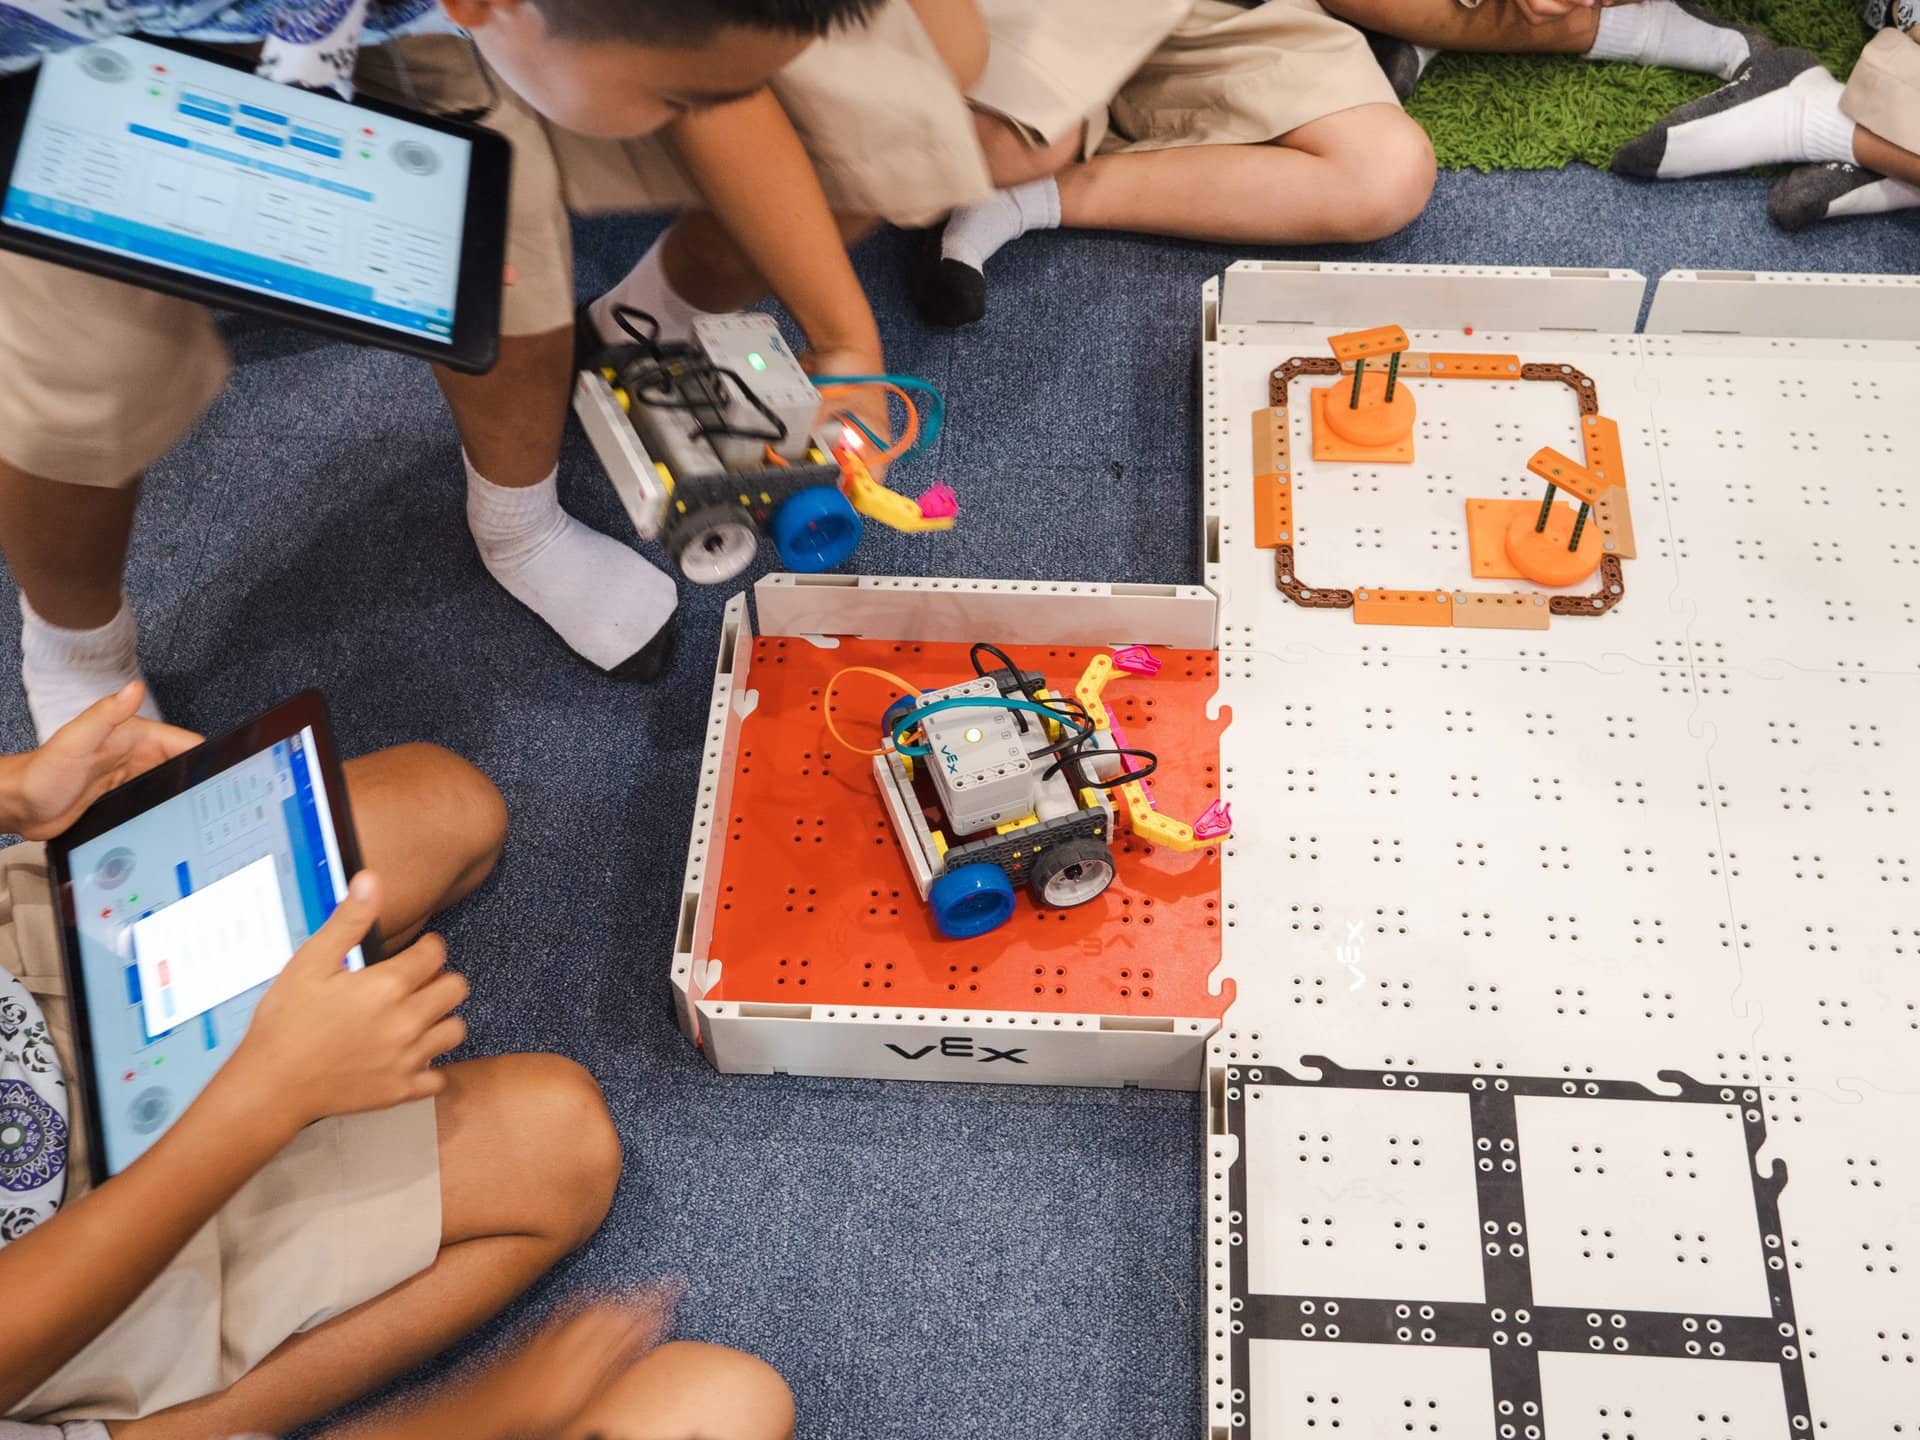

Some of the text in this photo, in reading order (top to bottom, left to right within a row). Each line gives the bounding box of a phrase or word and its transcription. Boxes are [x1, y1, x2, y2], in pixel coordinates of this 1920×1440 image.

[941, 745, 958, 774] VEX
[1336, 920, 1366, 992] VEX
[884, 1036, 1029, 1064] VEX
